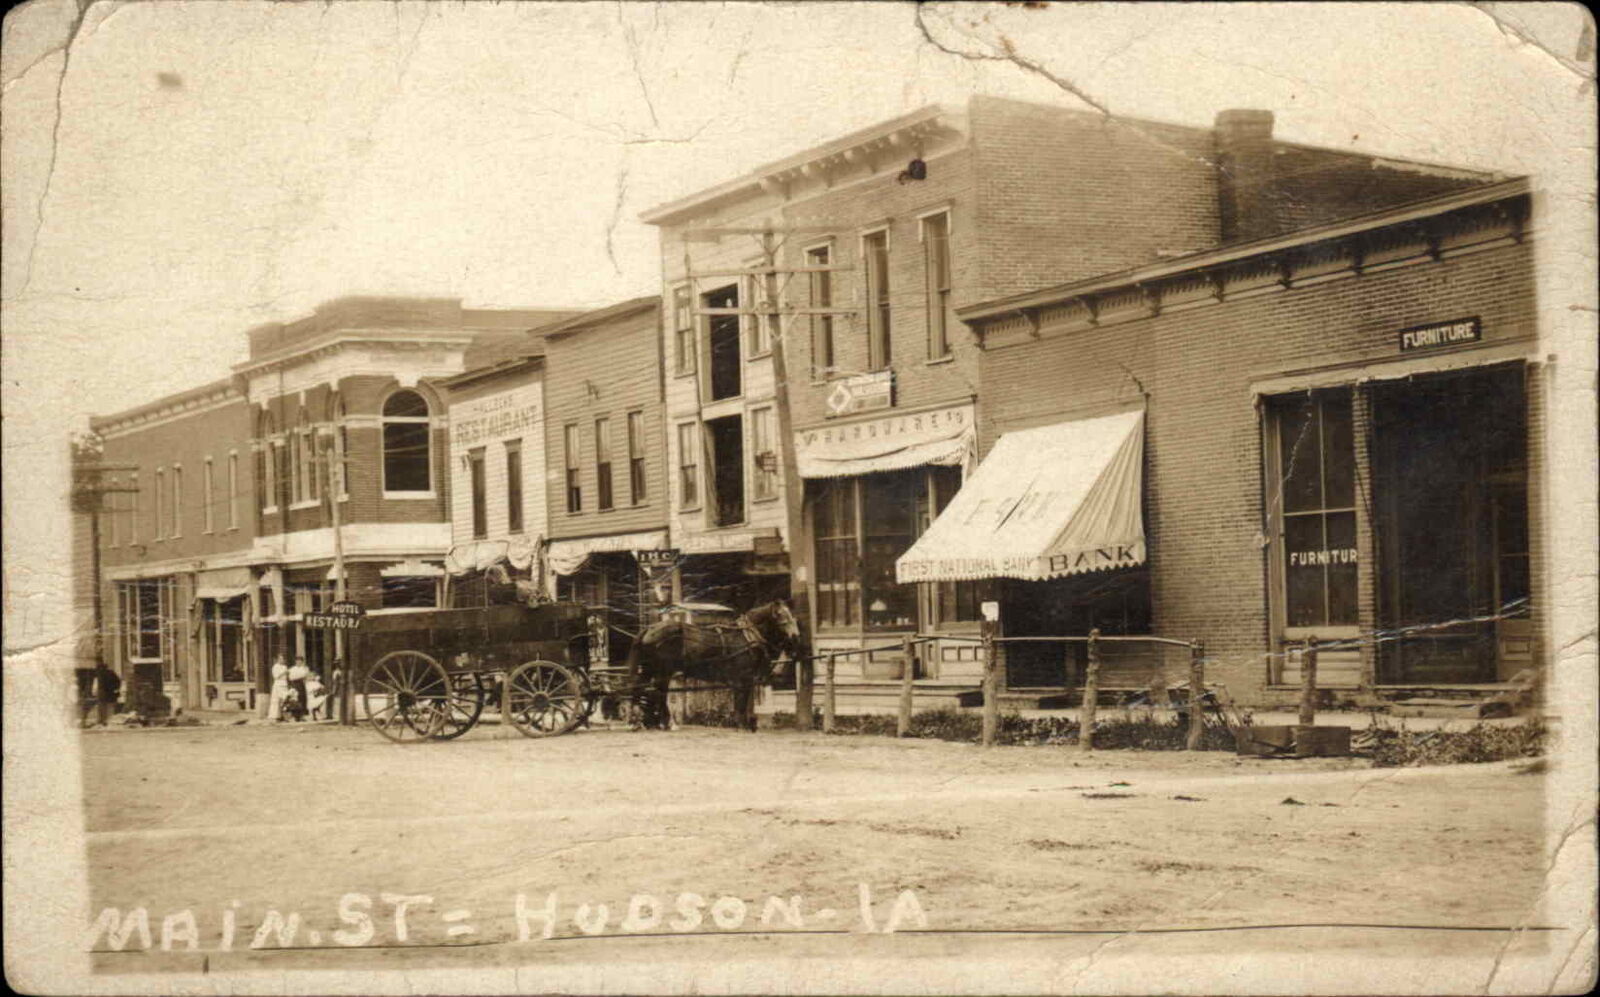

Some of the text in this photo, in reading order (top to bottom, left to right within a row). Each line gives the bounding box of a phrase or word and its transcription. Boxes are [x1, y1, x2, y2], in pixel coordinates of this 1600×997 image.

[1403, 322, 1475, 349] FURNITURE
[939, 558, 996, 575] NATIONAL
[1050, 546, 1136, 573] BANK
[332, 604, 359, 614] HOTEL
